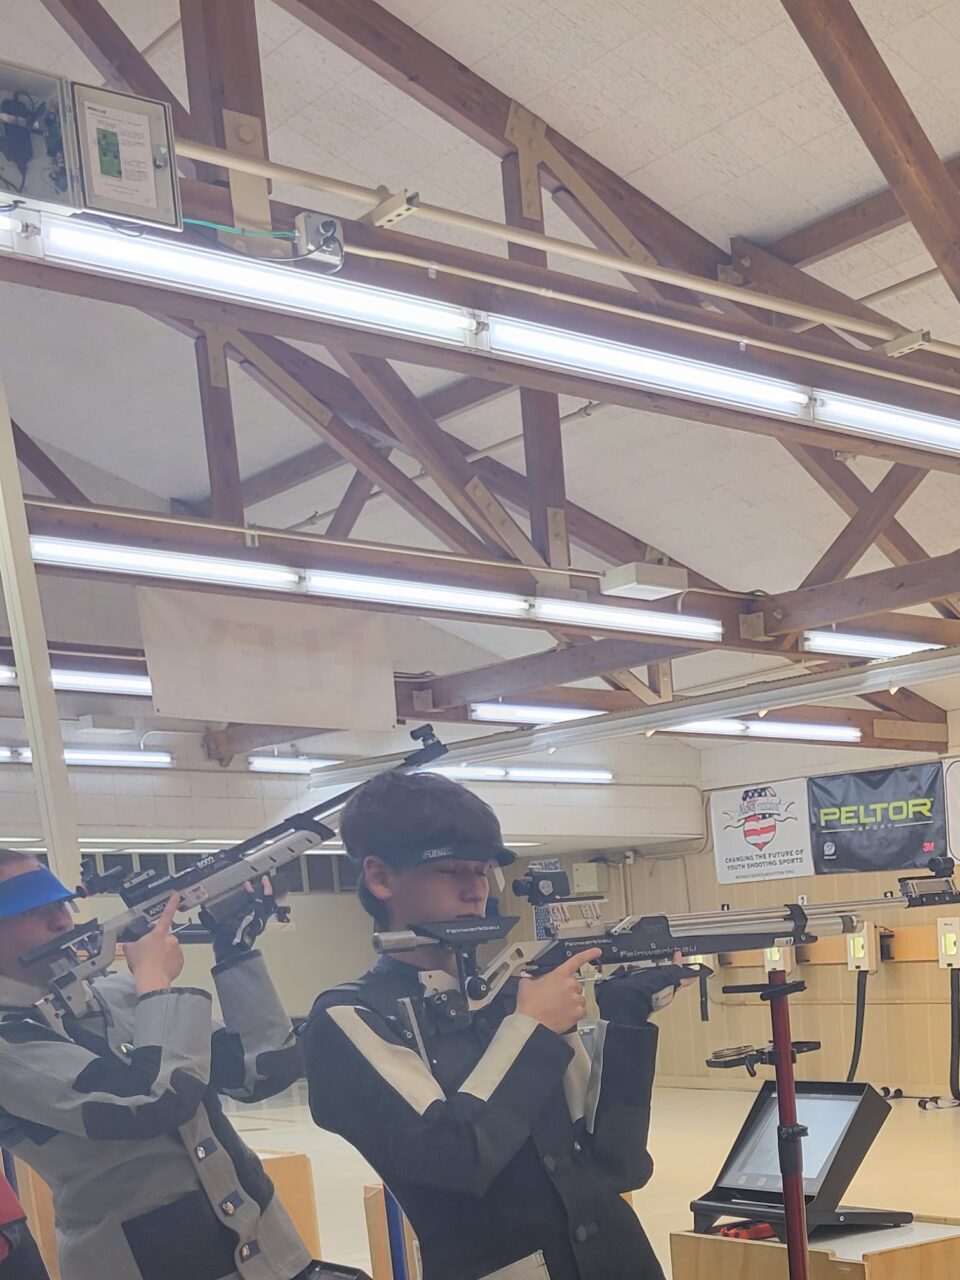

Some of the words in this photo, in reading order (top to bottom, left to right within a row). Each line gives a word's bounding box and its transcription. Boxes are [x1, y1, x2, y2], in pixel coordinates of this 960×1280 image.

[820, 798, 933, 827] PELTOR
[858, 824, 893, 832] SPORT
[922, 841, 935, 853] 3M
[725, 854, 754, 864] CHANGING
[768, 850, 793, 859] FUTURE
[795, 848, 805, 857] OF
[727, 863, 745, 871] YOUTH
[747, 860, 777, 870] SHOOTING
[779, 856, 804, 866] SPORTS
